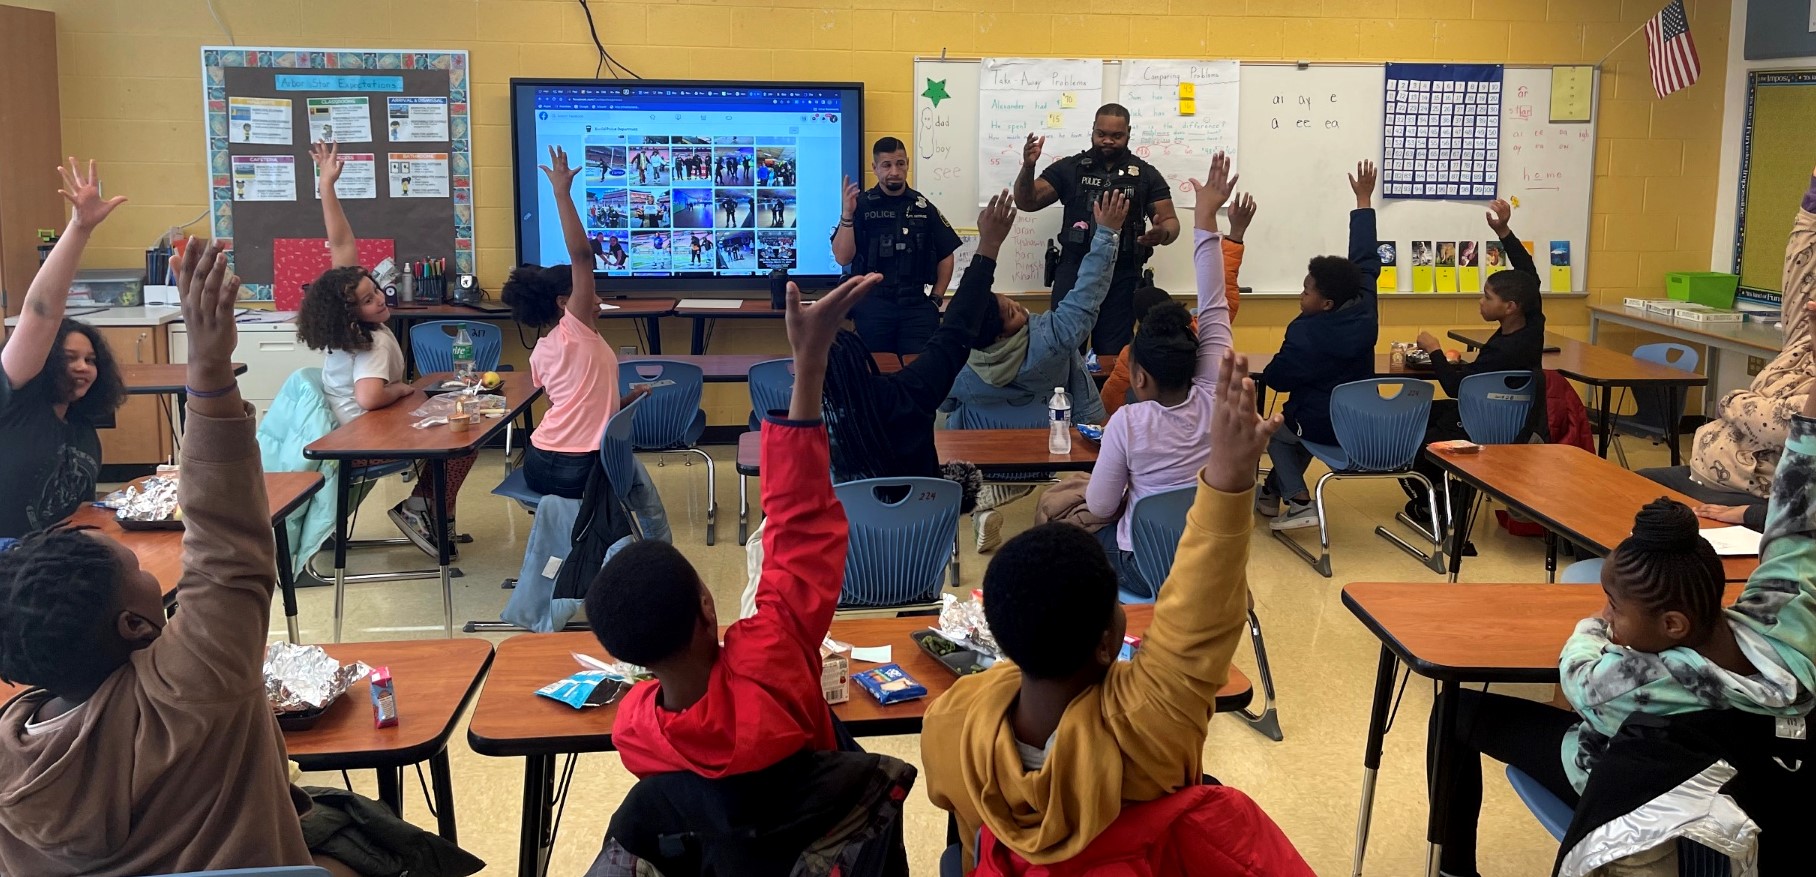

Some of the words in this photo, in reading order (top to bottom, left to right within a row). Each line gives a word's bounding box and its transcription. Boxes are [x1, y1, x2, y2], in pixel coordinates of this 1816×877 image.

[280, 78, 304, 88] Arbor
[311, 79, 330, 88] Star
[338, 79, 397, 90] Expectations
[1052, 72, 1087, 87] Problems
[1143, 66, 1180, 90] Comparing
[1190, 66, 1219, 79] Problems
[991, 99, 1025, 110] Alexander
[1035, 101, 1048, 109] had
[1298, 95, 1311, 111] ay
[1330, 93, 1338, 103] e
[935, 115, 949, 127] dad
[991, 120, 1001, 129] He
[1008, 121, 1027, 133] spent
[1271, 117, 1279, 129] a
[1296, 119, 1312, 128] ee
[1325, 119, 1340, 129] ea
[935, 139, 951, 160] boy
[933, 166, 961, 181] see
[1081, 176, 1102, 187] POLICE
[864, 210, 896, 220] POLICE
[919, 491, 937, 501] 224
